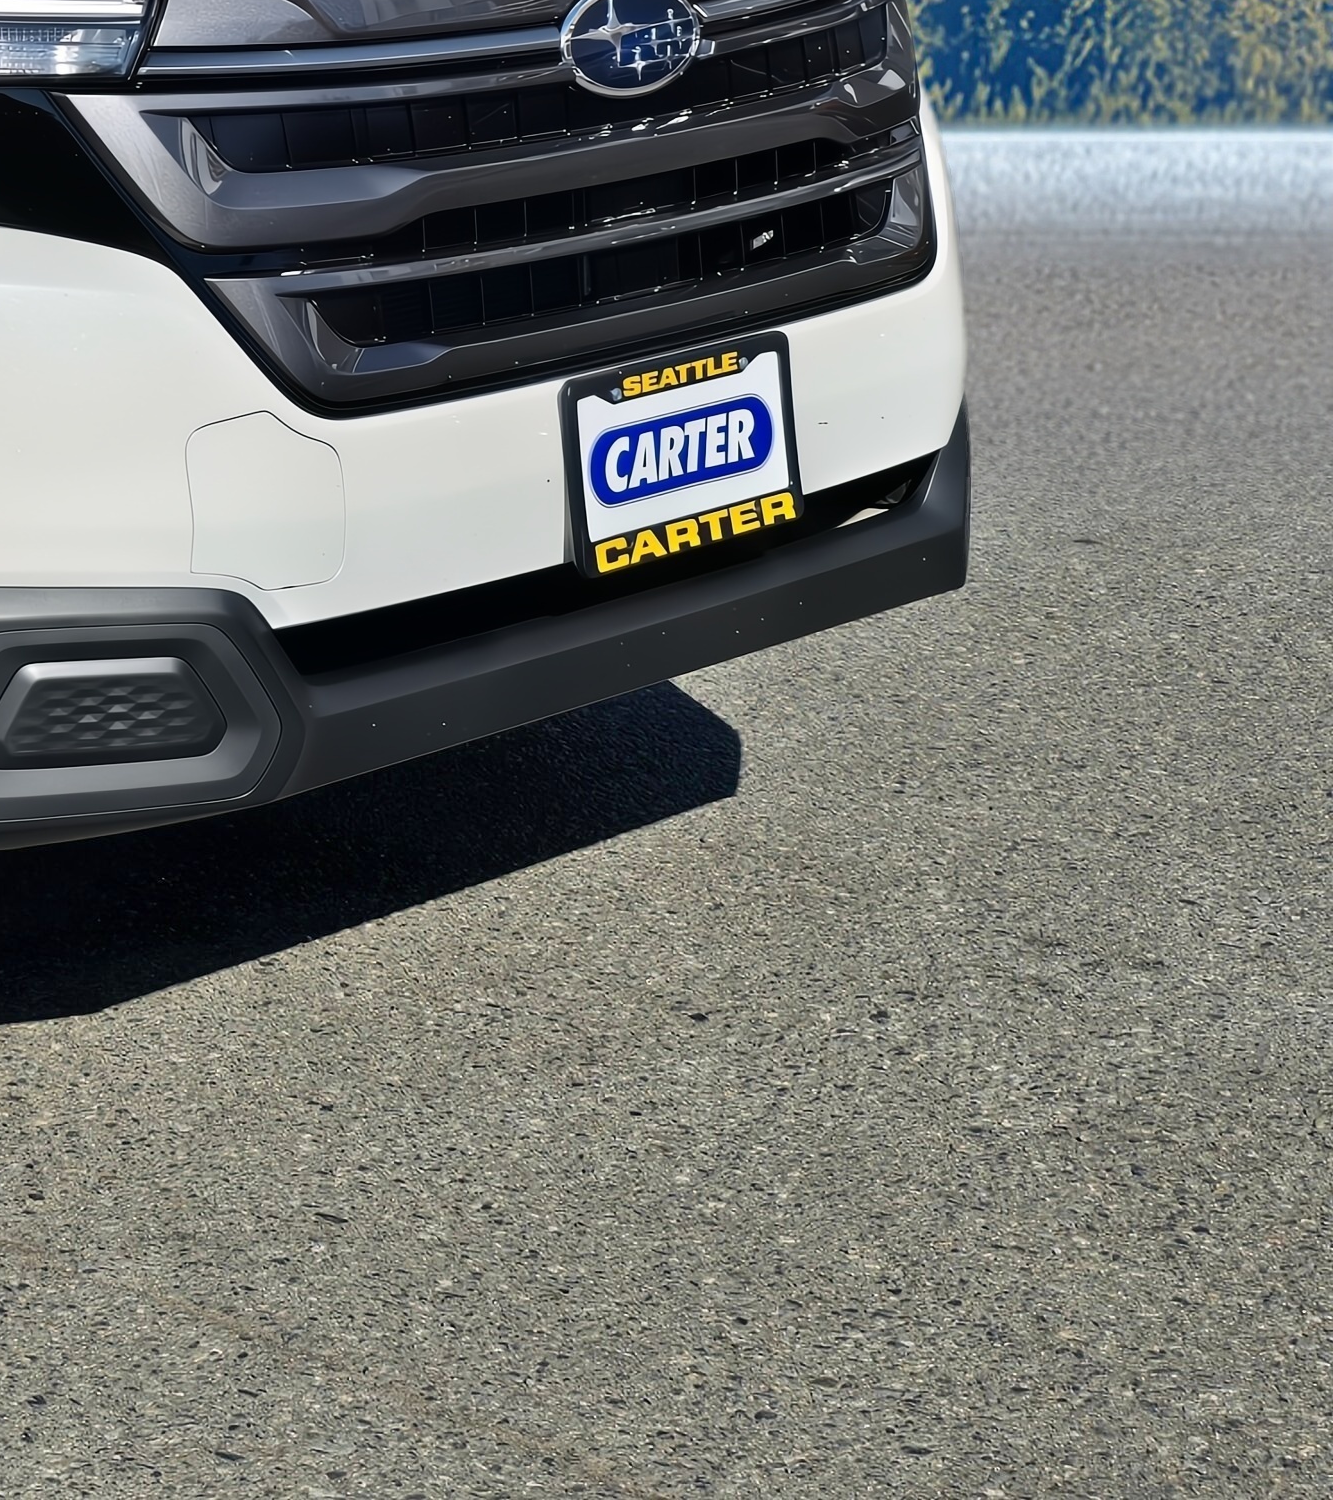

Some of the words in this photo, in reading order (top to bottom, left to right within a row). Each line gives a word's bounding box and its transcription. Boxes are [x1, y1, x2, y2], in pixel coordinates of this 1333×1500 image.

[622, 351, 738, 398] SEATTLE
[604, 408, 756, 493] CARTER
[594, 491, 797, 574] CARTER
